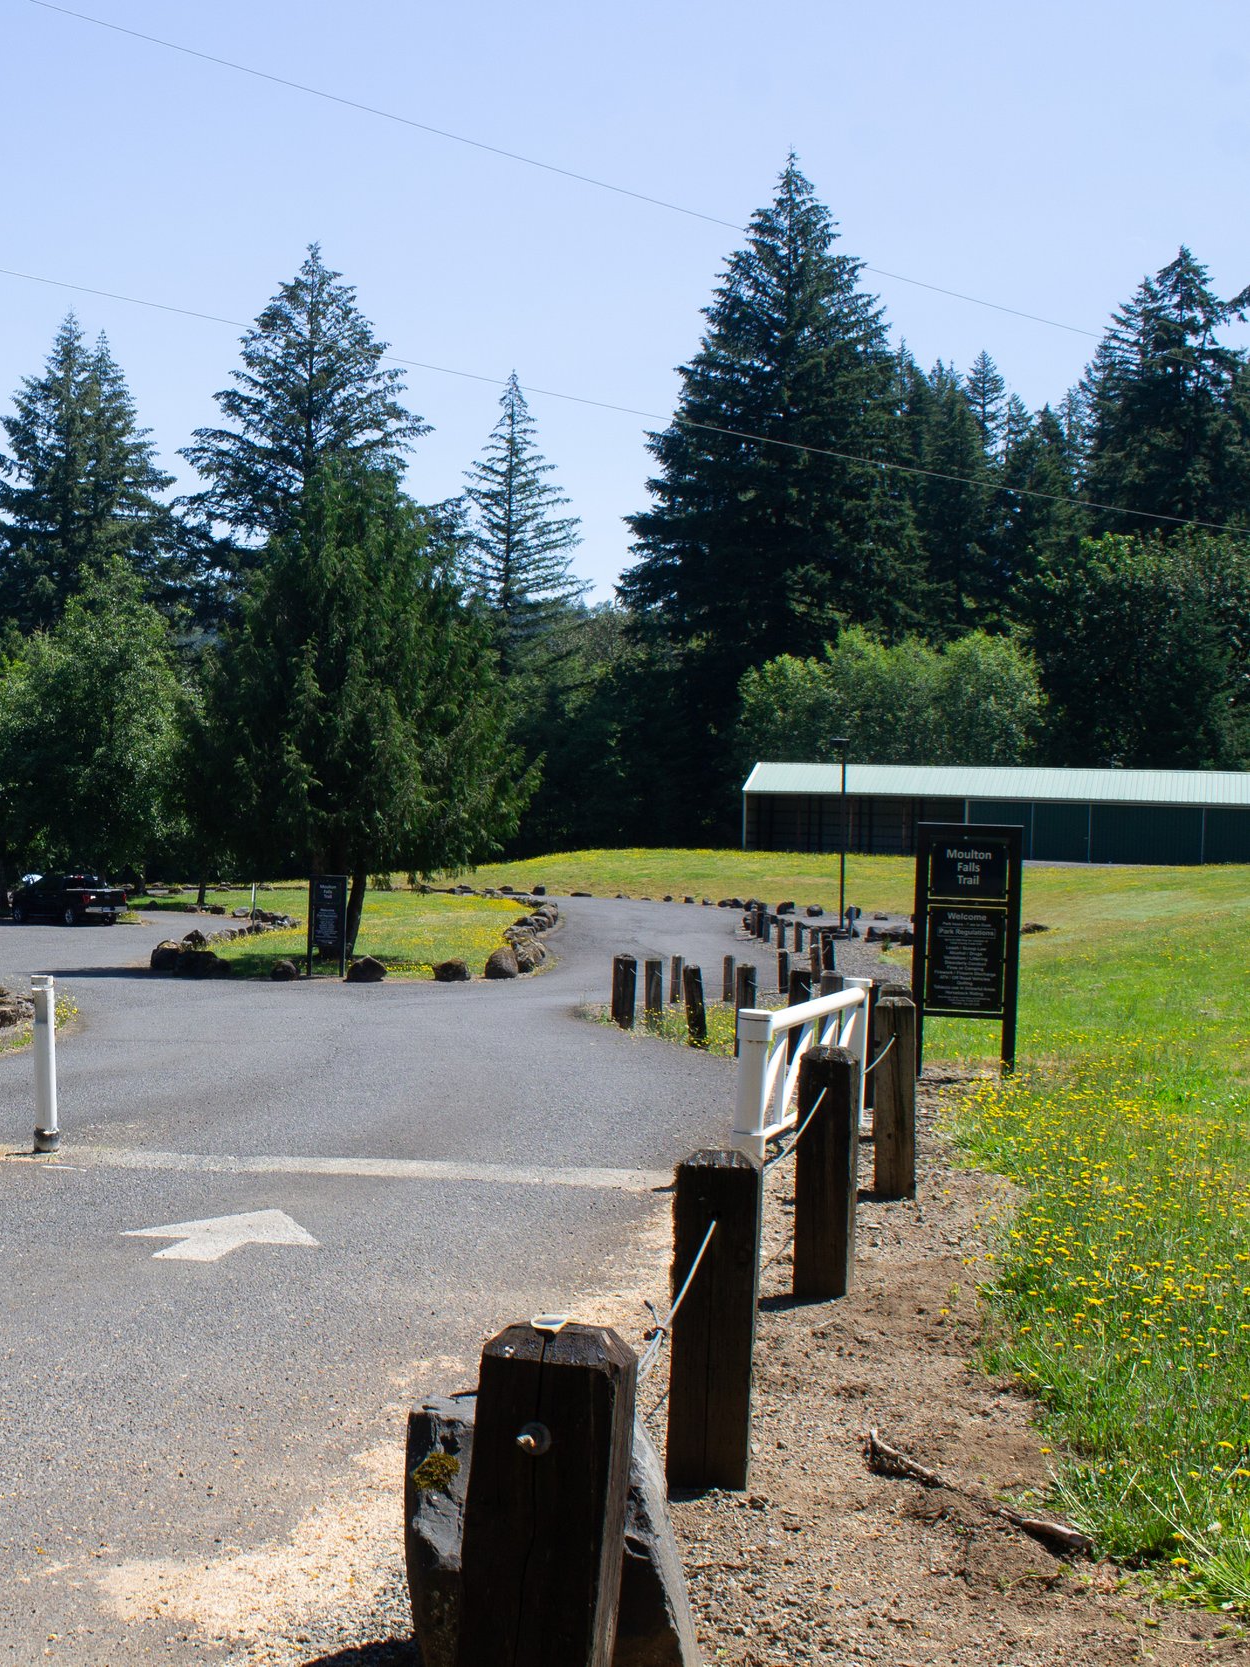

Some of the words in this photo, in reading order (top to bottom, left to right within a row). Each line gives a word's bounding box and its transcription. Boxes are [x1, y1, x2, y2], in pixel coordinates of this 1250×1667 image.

[946, 849, 992, 860] Moulton
[957, 862, 981, 873] Falls
[957, 875, 980, 885] Trail
[947, 912, 987, 921] Welcome
[955, 929, 994, 937] Regulations
